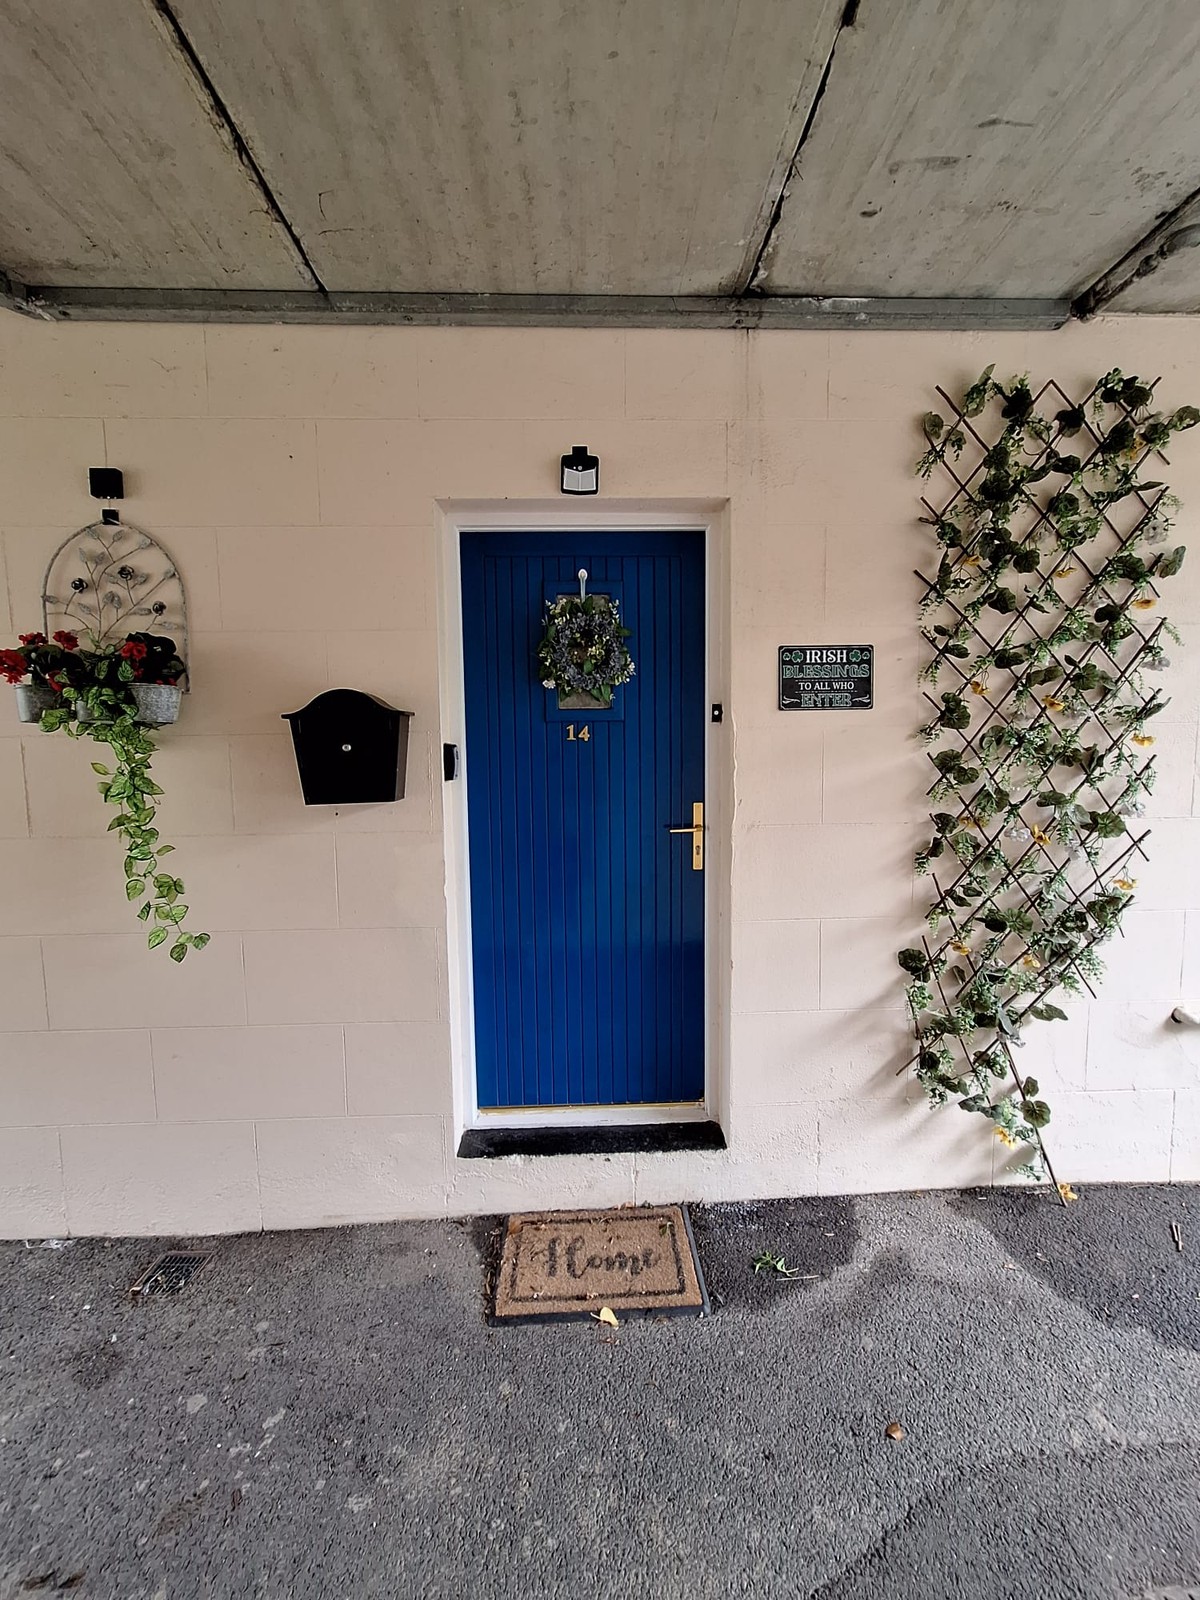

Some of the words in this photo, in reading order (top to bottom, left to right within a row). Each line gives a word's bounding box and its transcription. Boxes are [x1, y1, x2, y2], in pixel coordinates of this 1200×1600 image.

[806, 649, 848, 663] IRISH
[782, 664, 870, 678] BLESSINGS
[798, 682, 812, 690] TO
[814, 682, 830, 690] ALL
[832, 681, 855, 690] WHO
[800, 693, 852, 707] ENTER
[566, 724, 590, 742] 14
[529, 1235, 661, 1279] Home
